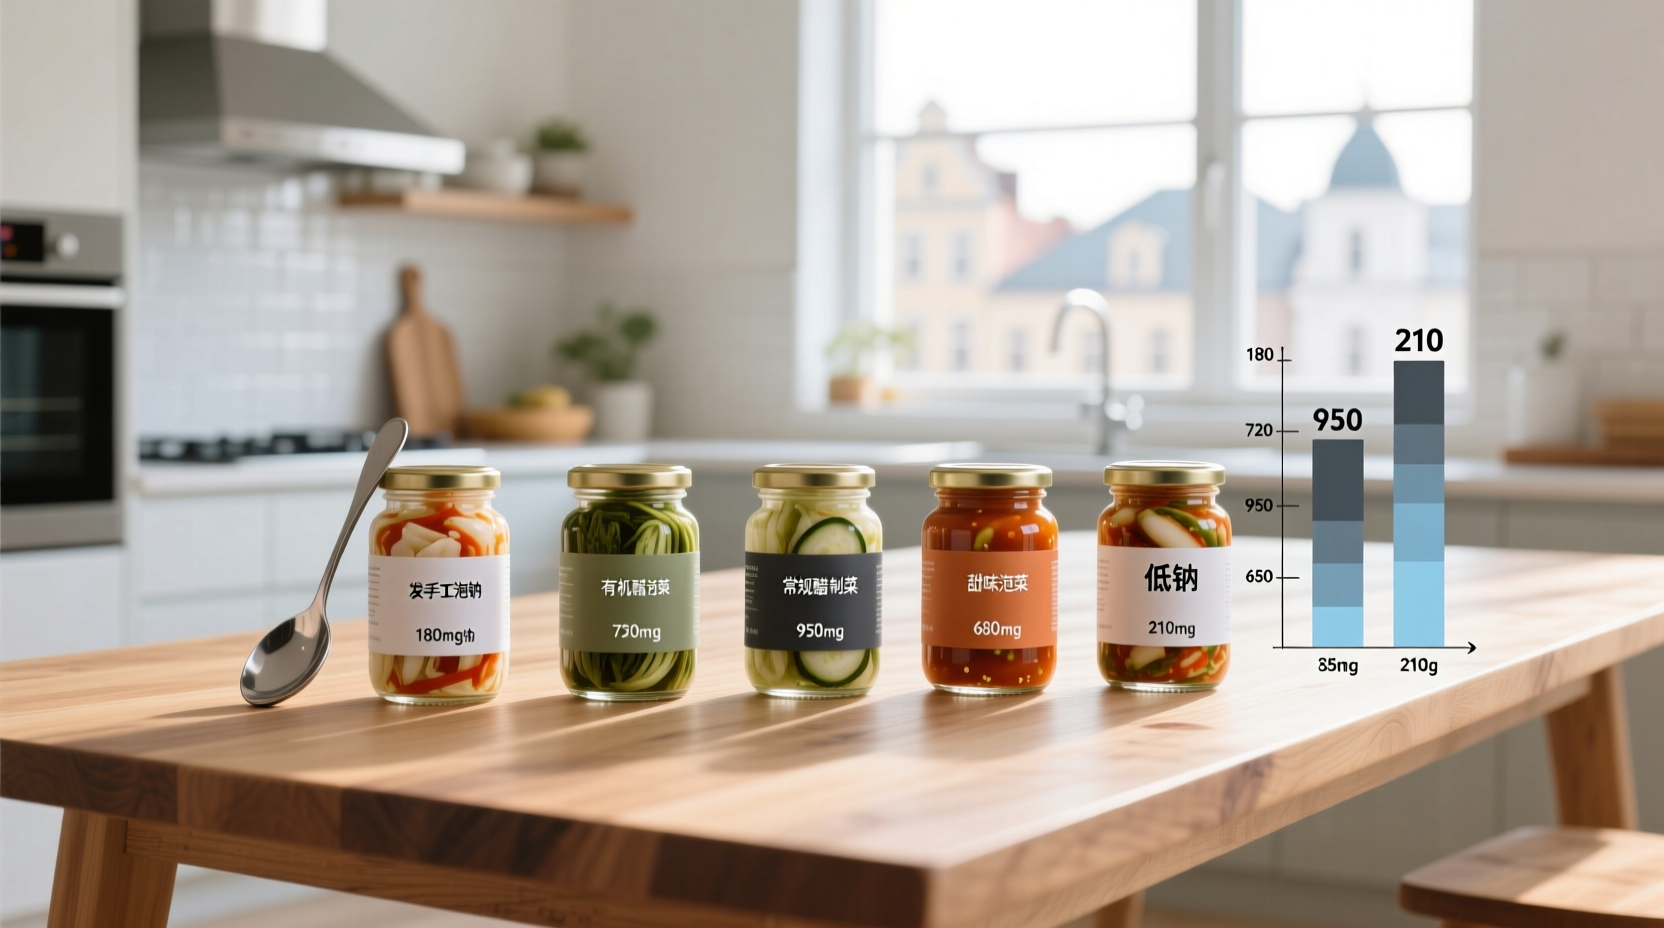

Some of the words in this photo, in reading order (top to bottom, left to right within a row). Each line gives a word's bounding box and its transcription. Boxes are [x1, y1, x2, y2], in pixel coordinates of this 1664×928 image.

[1144, 563, 1198, 592] 低钠
[796, 622, 844, 642] 950mg
[973, 620, 1022, 640] 680mg
[1148, 620, 1196, 639] 210mg
